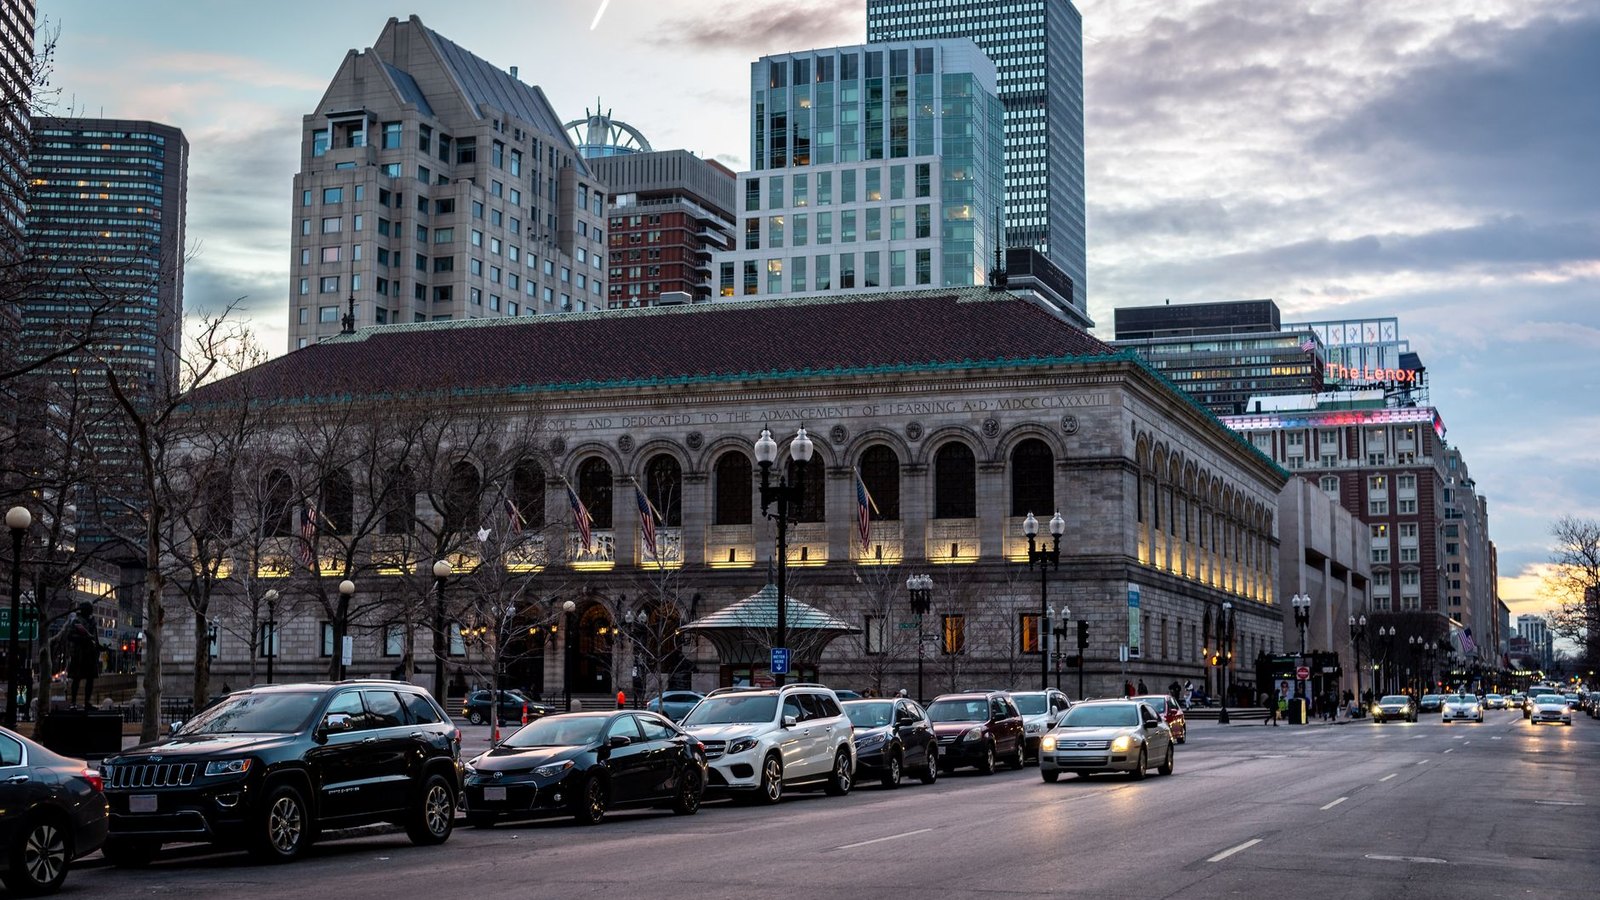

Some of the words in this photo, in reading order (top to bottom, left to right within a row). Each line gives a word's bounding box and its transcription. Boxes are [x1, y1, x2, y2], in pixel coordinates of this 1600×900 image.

[1325, 362, 1360, 380] The
[1364, 364, 1416, 381] Lenox
[587, 417, 612, 429] AND
[622, 414, 691, 428] DEDICATED
[701, 412, 719, 424] TO
[726, 411, 750, 423] THE
[760, 407, 852, 420] ADVANCEMENT
[862, 404, 880, 417] OF
[889, 401, 956, 415] LEARNING
